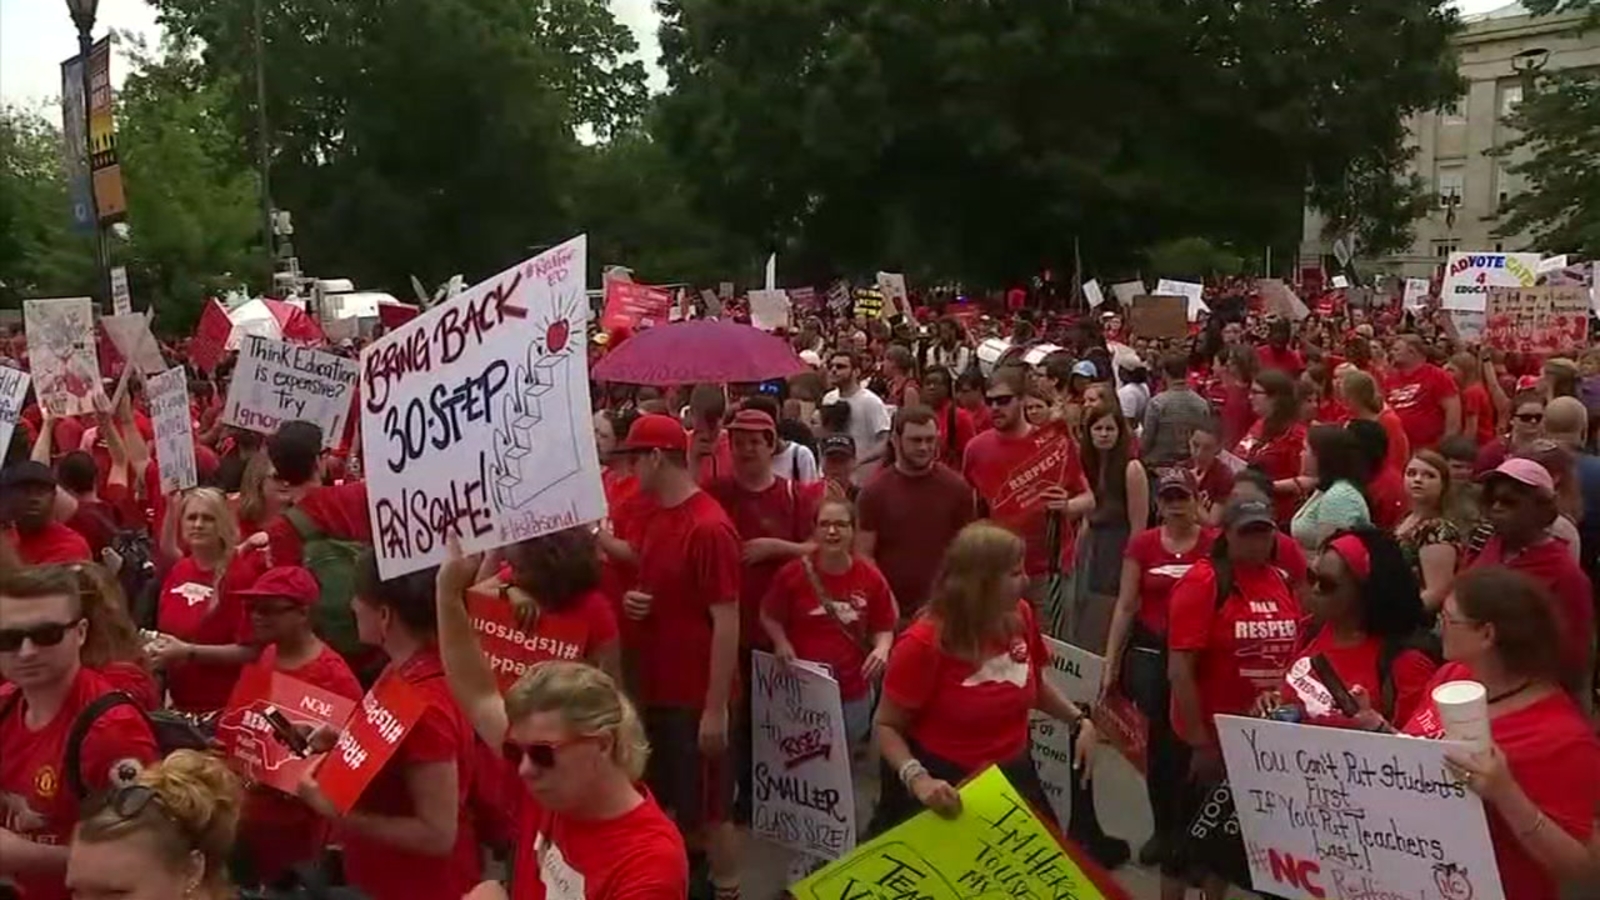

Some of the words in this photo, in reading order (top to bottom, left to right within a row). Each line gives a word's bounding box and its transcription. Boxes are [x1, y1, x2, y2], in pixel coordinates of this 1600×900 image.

[1476, 271, 1487, 285] 4
[434, 272, 529, 364] BACK
[247, 333, 291, 367] Think
[293, 346, 357, 385] Education
[255, 364, 268, 382] is
[1008, 449, 1061, 491] RESPECT
[375, 488, 412, 559] PAY
[412, 451, 494, 554] SCALE!
[472, 617, 580, 660] #ItsPerson
[1052, 655, 1082, 679] NIAL
[1241, 728, 1291, 774] You
[1343, 751, 1377, 787] Put
[1379, 755, 1467, 799] Students
[755, 762, 846, 823] SMALLER
[1279, 794, 1319, 829] You
[1343, 809, 1445, 862] Teachers
